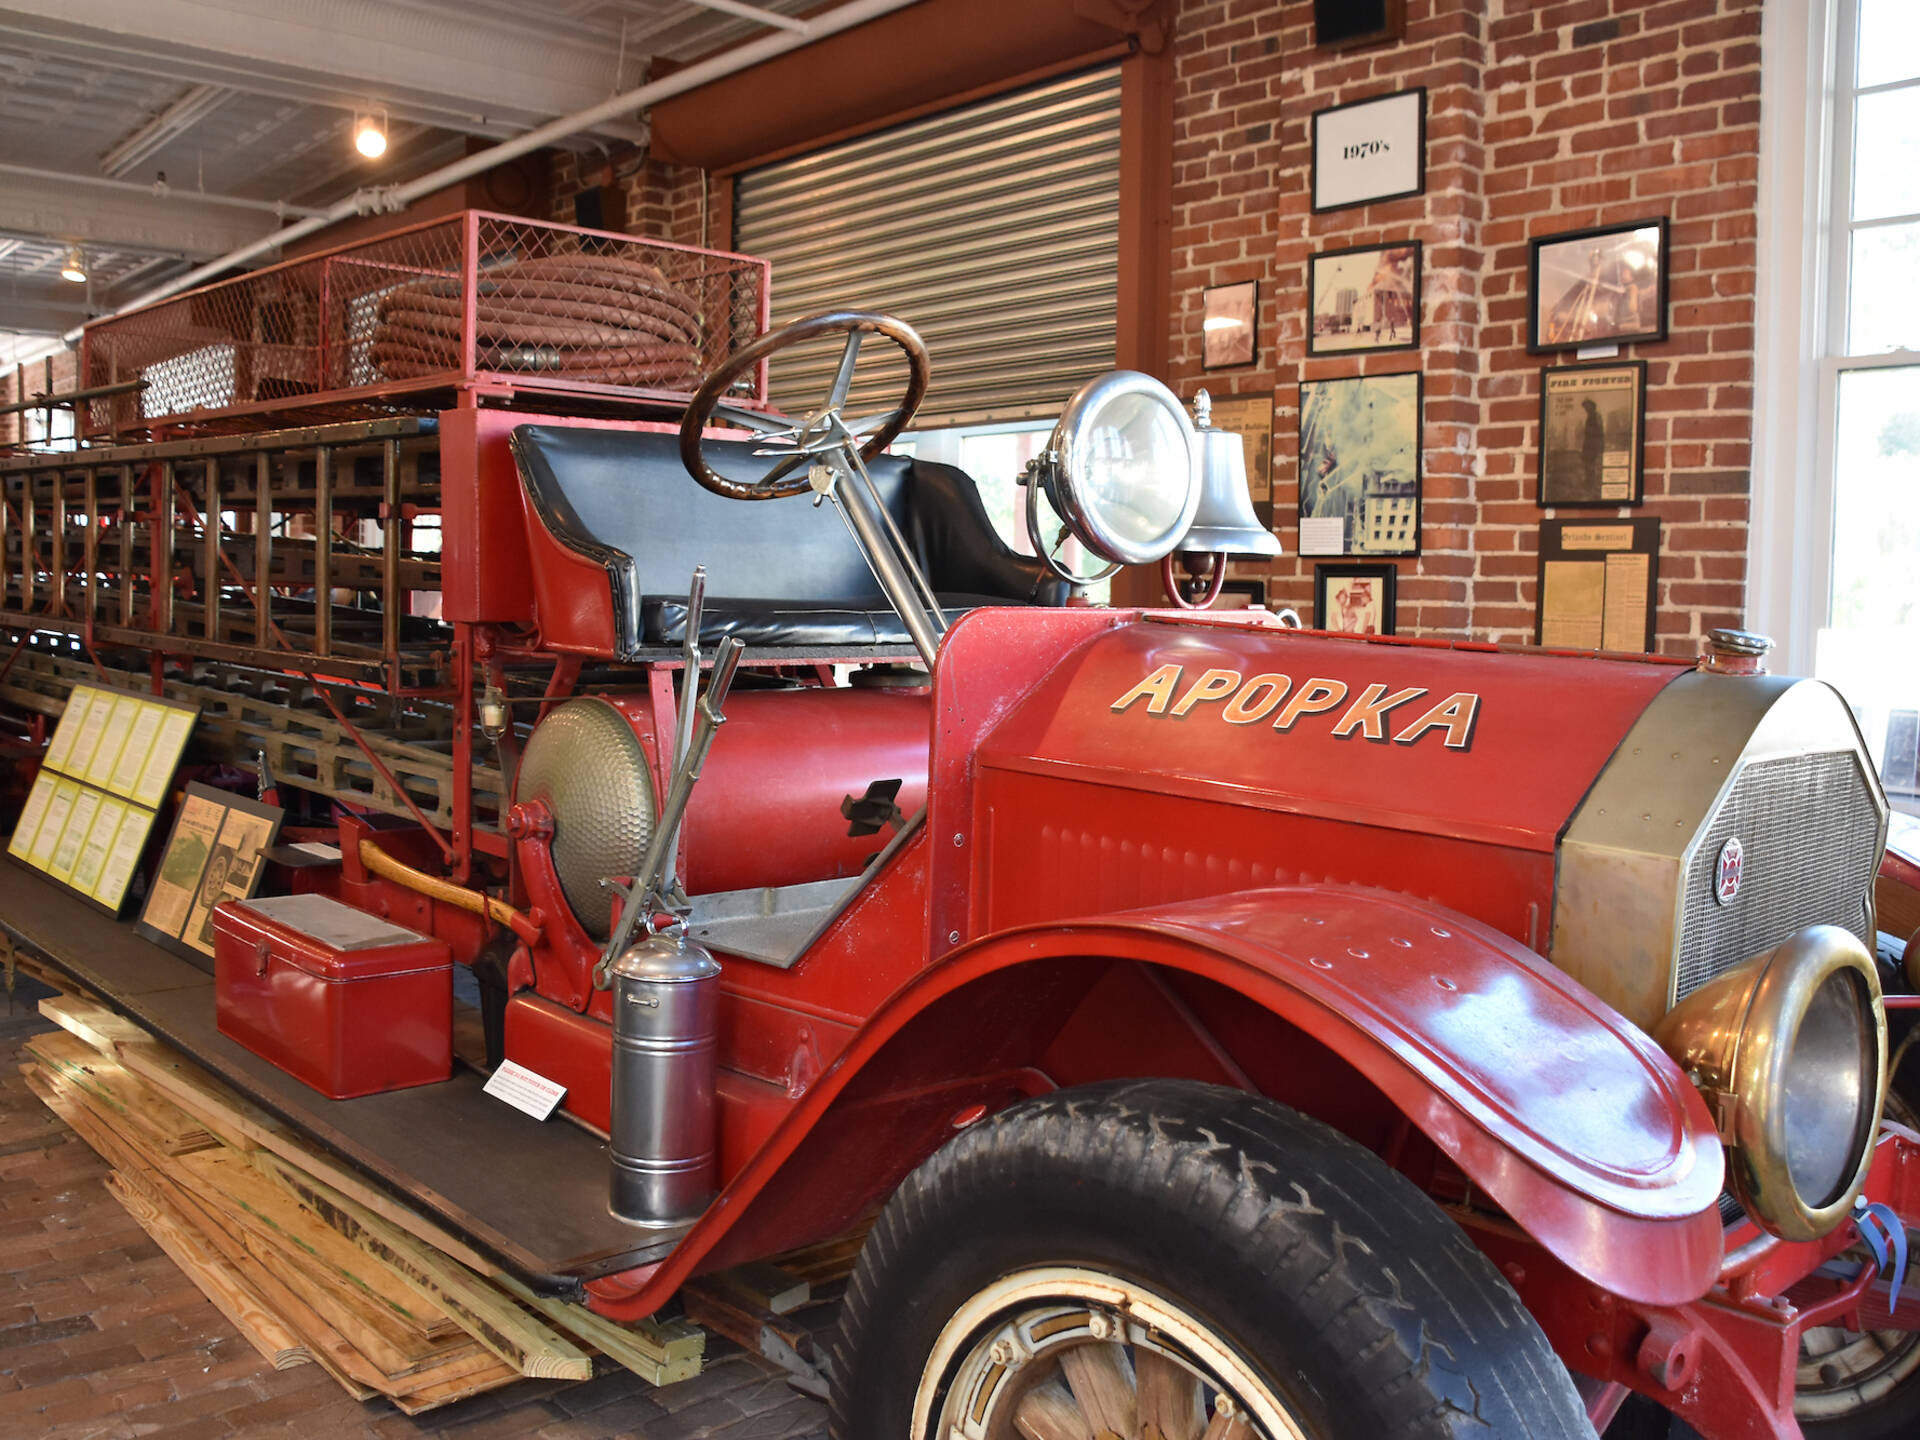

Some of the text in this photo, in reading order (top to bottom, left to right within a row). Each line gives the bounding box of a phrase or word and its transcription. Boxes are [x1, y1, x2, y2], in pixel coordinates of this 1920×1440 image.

[1344, 140, 1390, 160] 1970's
[1550, 375, 1631, 388] FIRE FIGHTER
[1110, 663, 1480, 749] APOPKA
